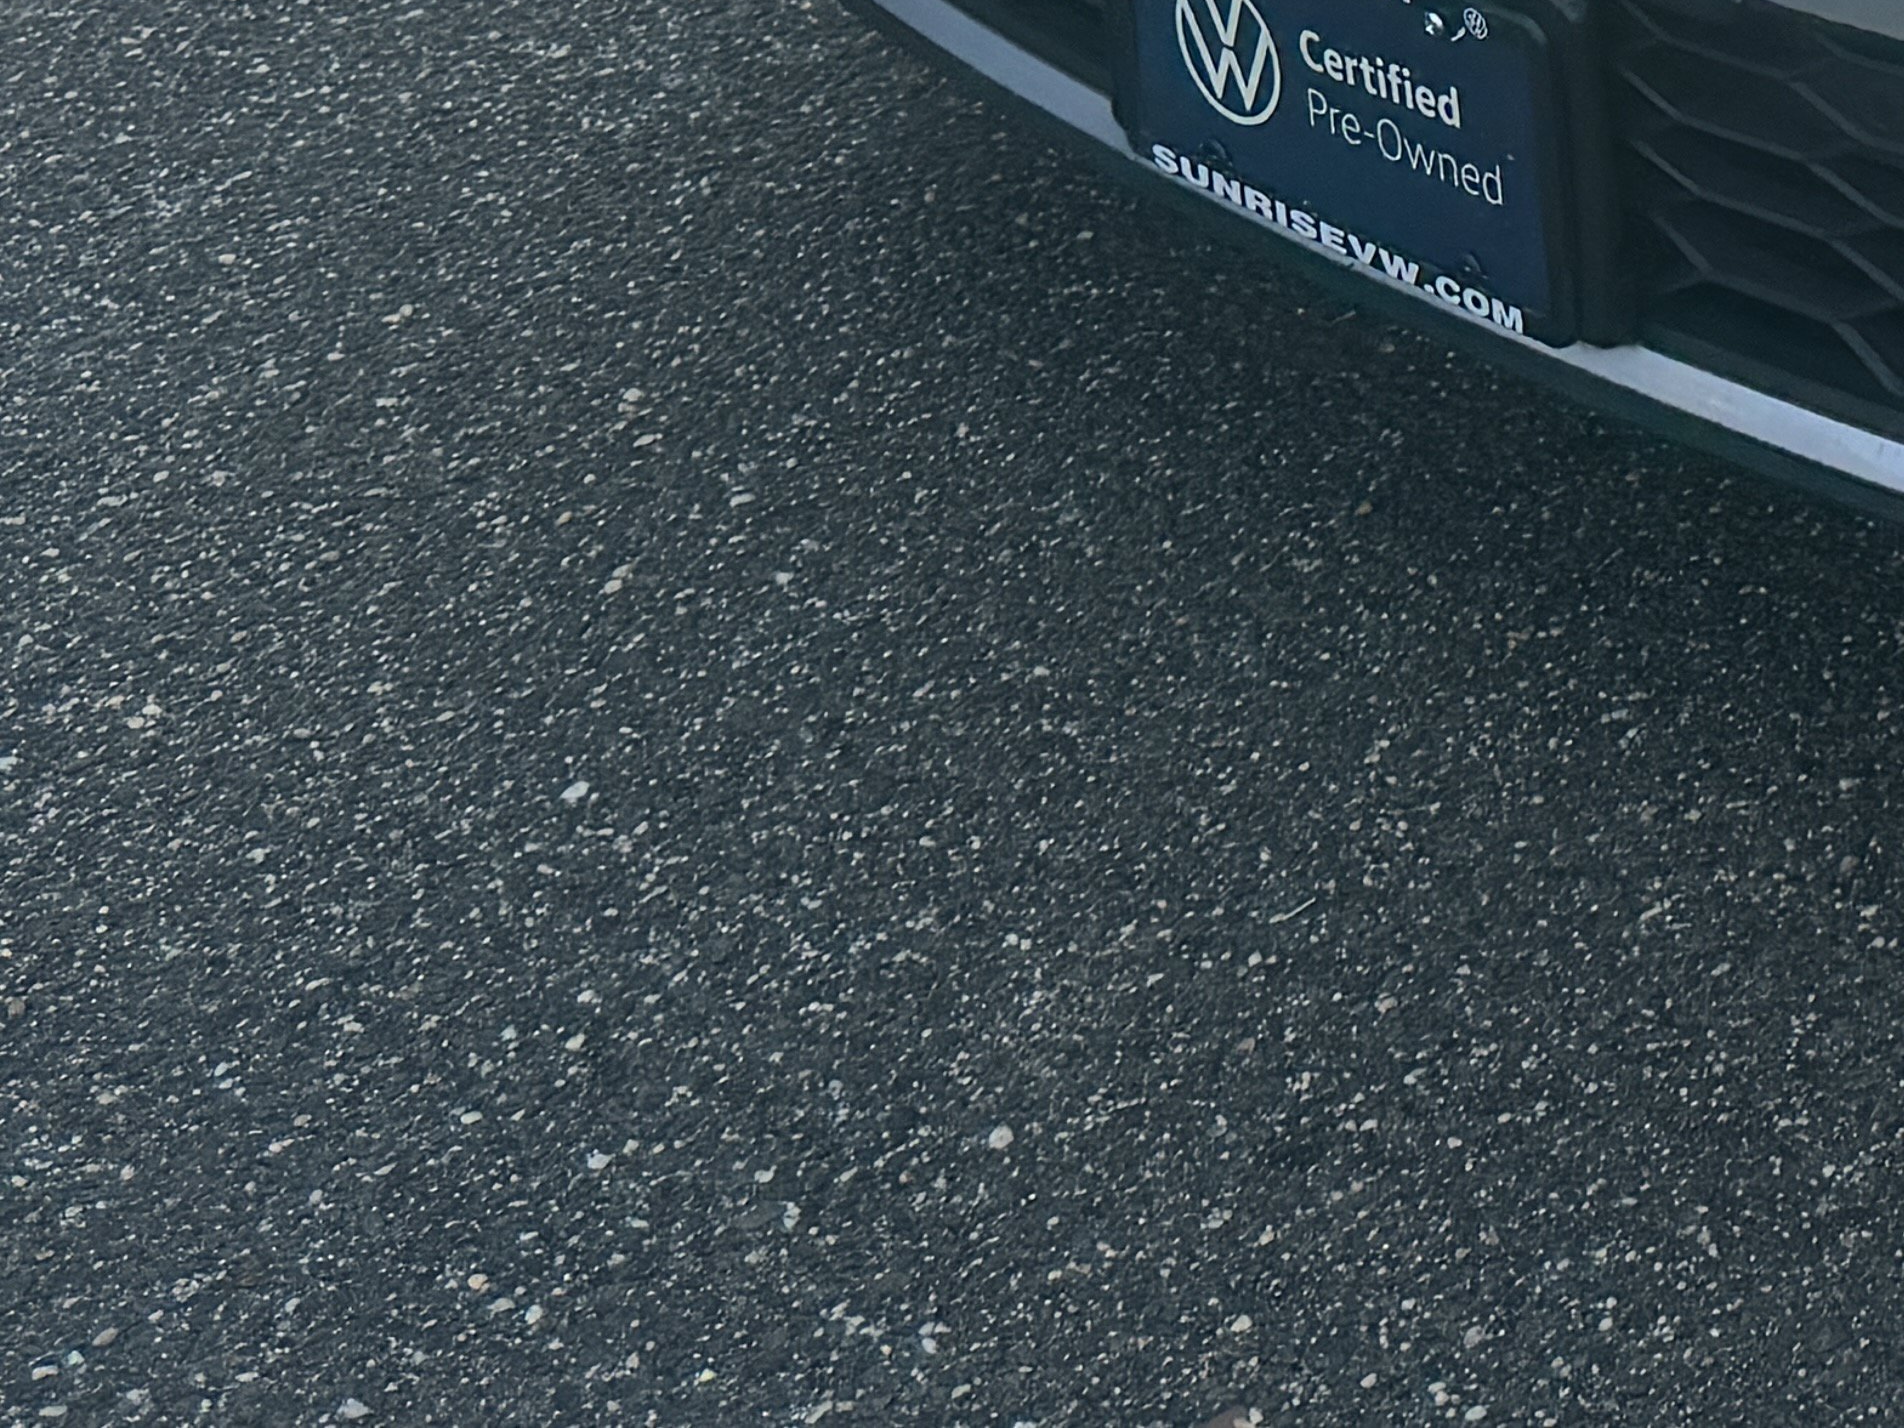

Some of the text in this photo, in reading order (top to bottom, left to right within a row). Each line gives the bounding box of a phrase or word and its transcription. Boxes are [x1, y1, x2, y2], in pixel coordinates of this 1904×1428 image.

[1299, 29, 1461, 128] Certified
[1307, 87, 1504, 205] Pre-Owned
[1151, 143, 1524, 334] SUNRISEVW.COM
